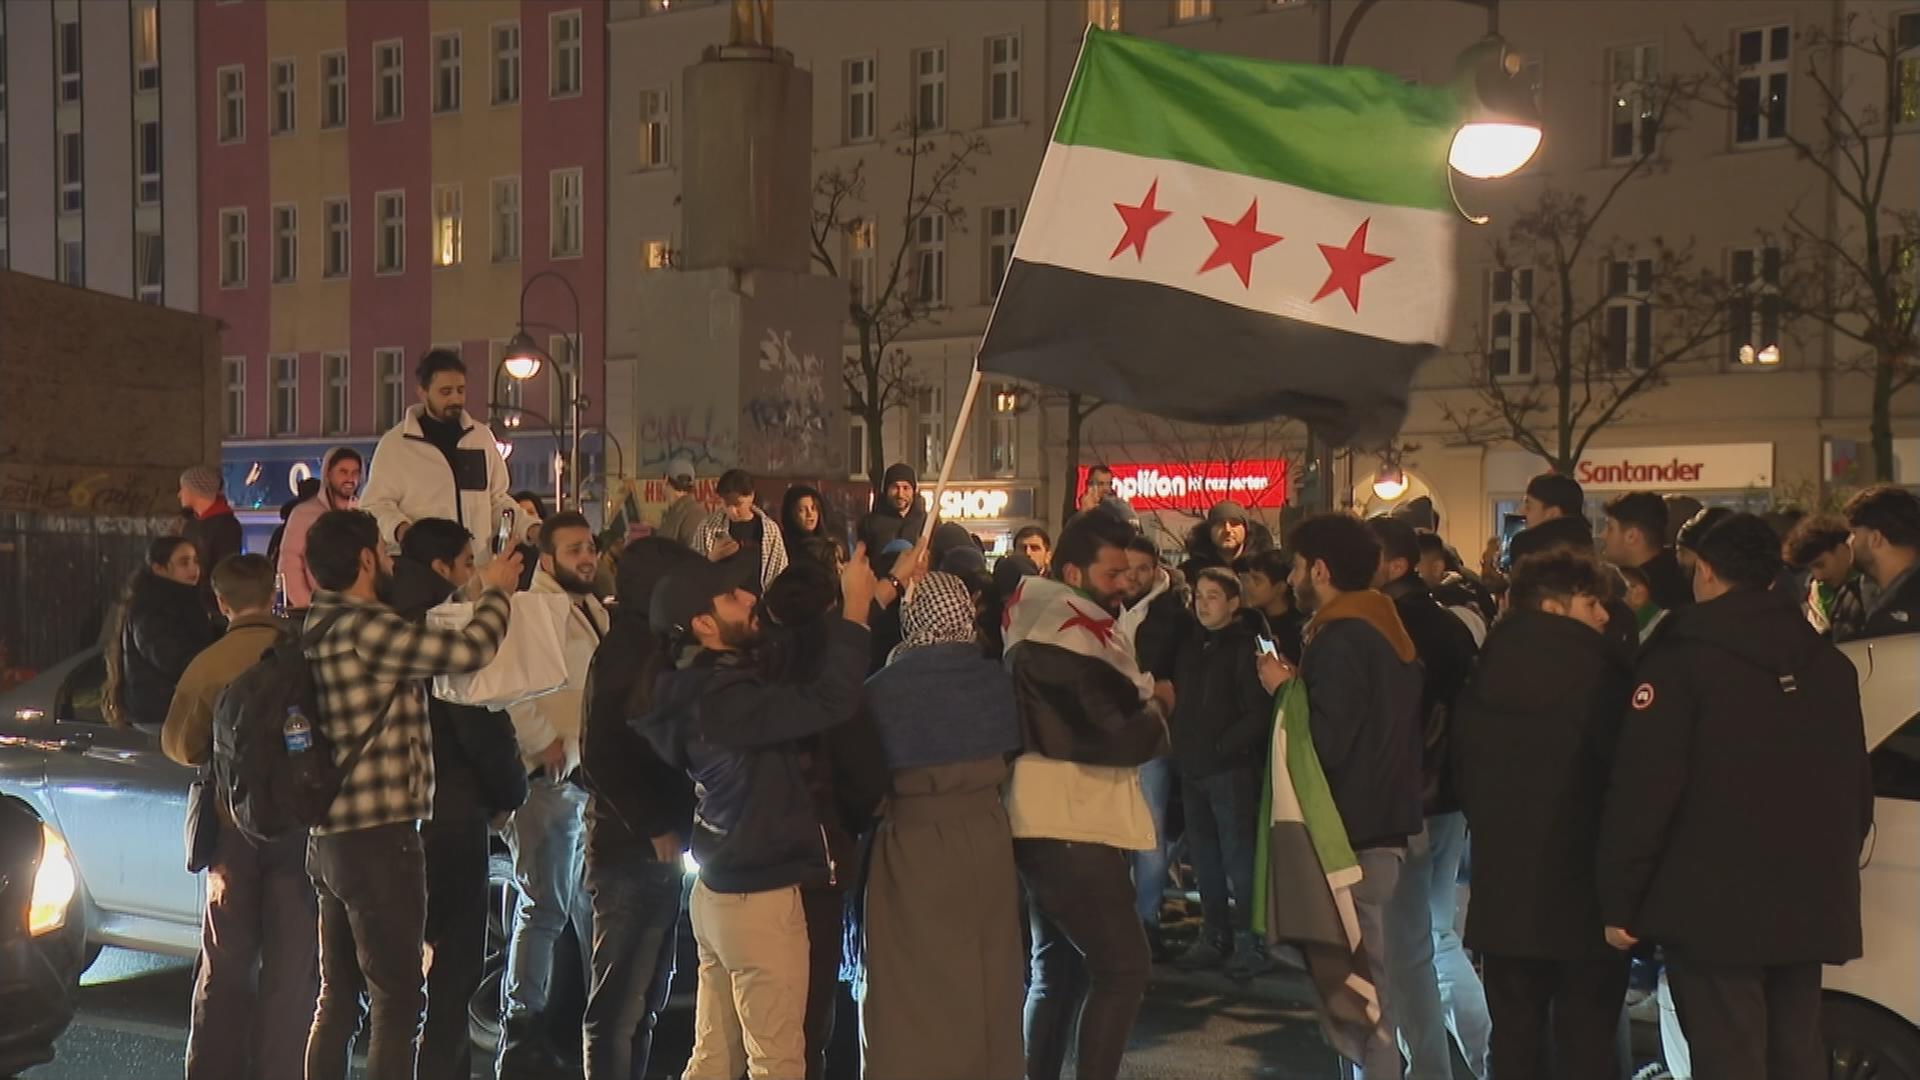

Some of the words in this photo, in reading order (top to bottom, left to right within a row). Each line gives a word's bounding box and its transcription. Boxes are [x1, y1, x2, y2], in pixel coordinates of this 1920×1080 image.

[1111, 469, 1186, 502] mplifon
[1578, 458, 1704, 485] Santander
[940, 490, 1008, 518] SHOP
